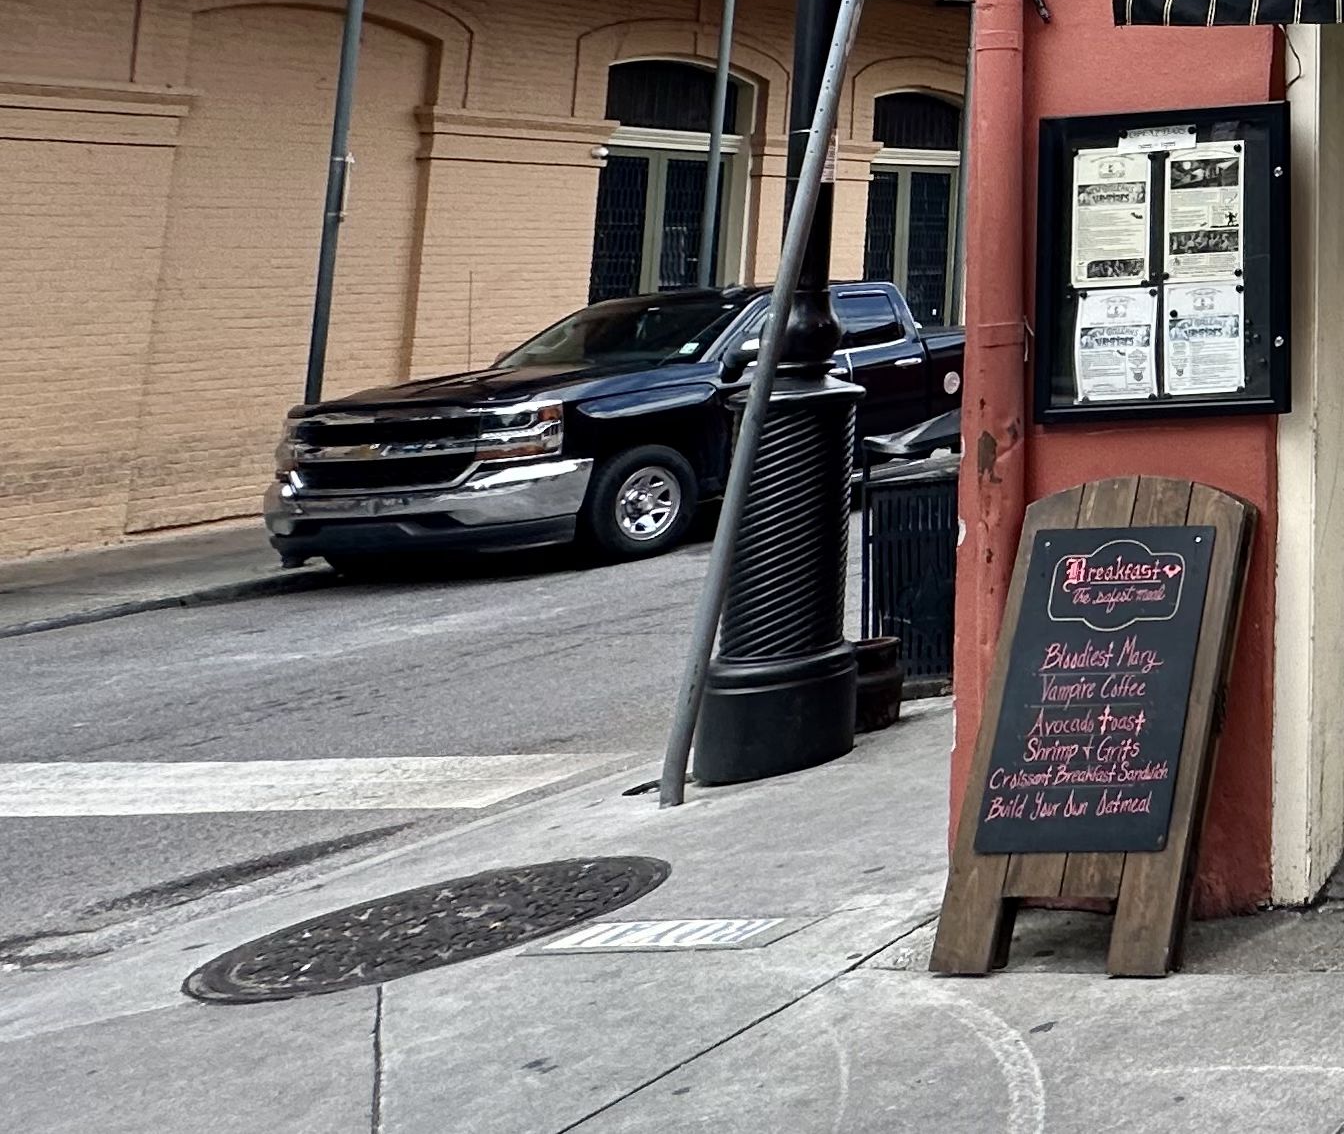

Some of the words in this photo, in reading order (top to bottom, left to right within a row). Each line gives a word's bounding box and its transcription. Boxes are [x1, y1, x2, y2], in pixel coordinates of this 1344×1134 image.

[1062, 556, 1161, 593] Breakfast
[1071, 587, 1091, 604] The
[1040, 639, 1114, 671] Bloodiest
[1118, 636, 1162, 673] Mary
[1042, 675, 1096, 710] Vampire
[1100, 676, 1146, 699] Coffee
[1028, 711, 1094, 736] Avocado
[1023, 737, 1078, 766] Shrimp
[1097, 737, 1140, 761] Grits
[1056, 764, 1117, 785] Breakfast
[986, 794, 1027, 822] Build
[1096, 791, 1152, 815] Oatmeal
